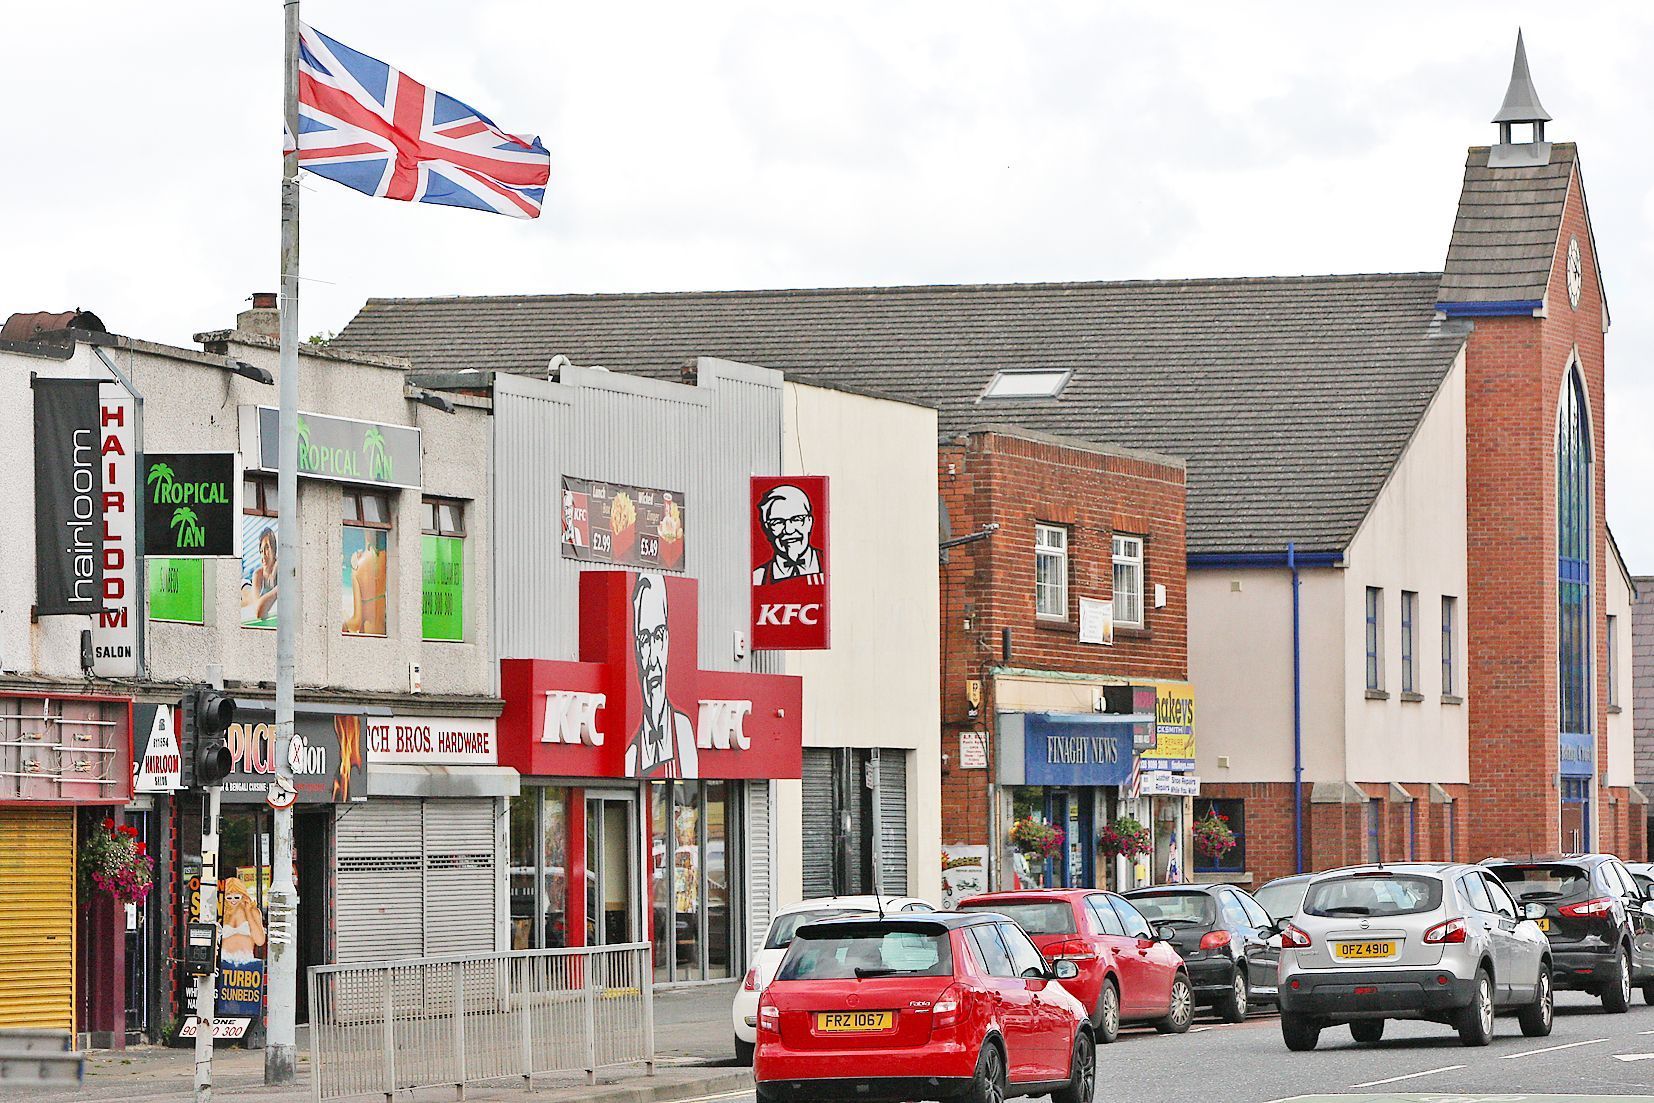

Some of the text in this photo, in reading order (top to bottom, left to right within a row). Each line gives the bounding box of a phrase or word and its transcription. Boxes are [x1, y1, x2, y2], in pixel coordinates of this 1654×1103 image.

[363, 426, 393, 480] TAN
[148, 463, 229, 503] TROPICAL
[66, 428, 93, 602] hairloom
[99, 405, 128, 628] HAIRLOOM
[574, 508, 588, 521] KFC
[170, 507, 205, 548] TAN
[593, 532, 611, 553] £2.99
[640, 537, 658, 557] £5.49
[756, 603, 820, 626] KFC
[95, 646, 131, 658] SALON
[541, 690, 606, 746] KFC
[1156, 691, 1193, 727] nakeys
[697, 700, 752, 751] KFC
[222, 723, 277, 775] PICE
[395, 725, 434, 753] BROS.
[438, 731, 490, 754] HARDWARE
[1047, 735, 1119, 765] FINAGHY NEWS
[145, 754, 179, 774] HAIRLOOM
[189, 877, 225, 891] ON
[190, 891, 224, 916] SN
[1342, 943, 1389, 955] OFZ 4910
[222, 969, 261, 988] TURBO
[220, 987, 260, 1003] SUNBEDS
[221, 1026, 243, 1037] 300
[825, 1013, 884, 1028] FRZ 1067
